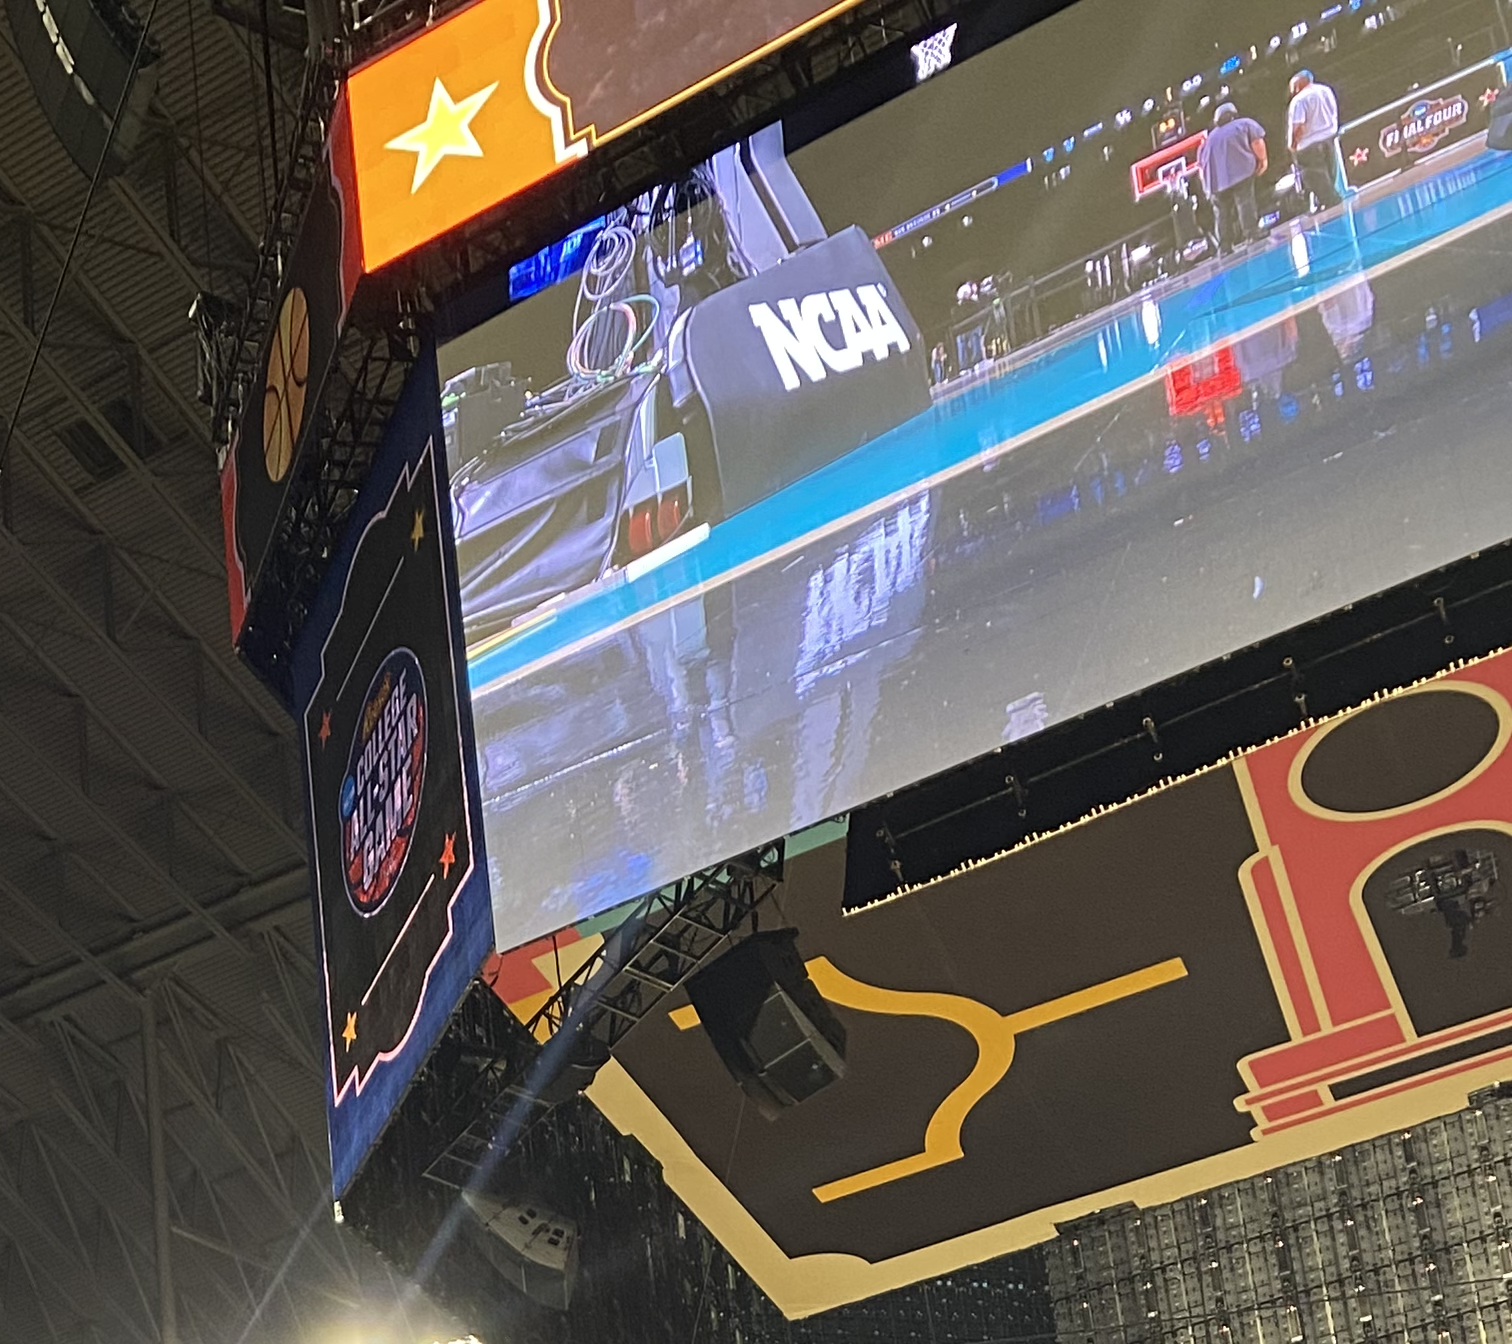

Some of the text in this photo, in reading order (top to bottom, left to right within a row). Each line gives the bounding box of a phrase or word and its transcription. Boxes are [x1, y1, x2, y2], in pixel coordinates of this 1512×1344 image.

[748, 282, 912, 392] NCAA
[349, 692, 418, 863] ALL-STAR
[356, 667, 407, 797] COLLEGE
[362, 753, 414, 892] GAME
